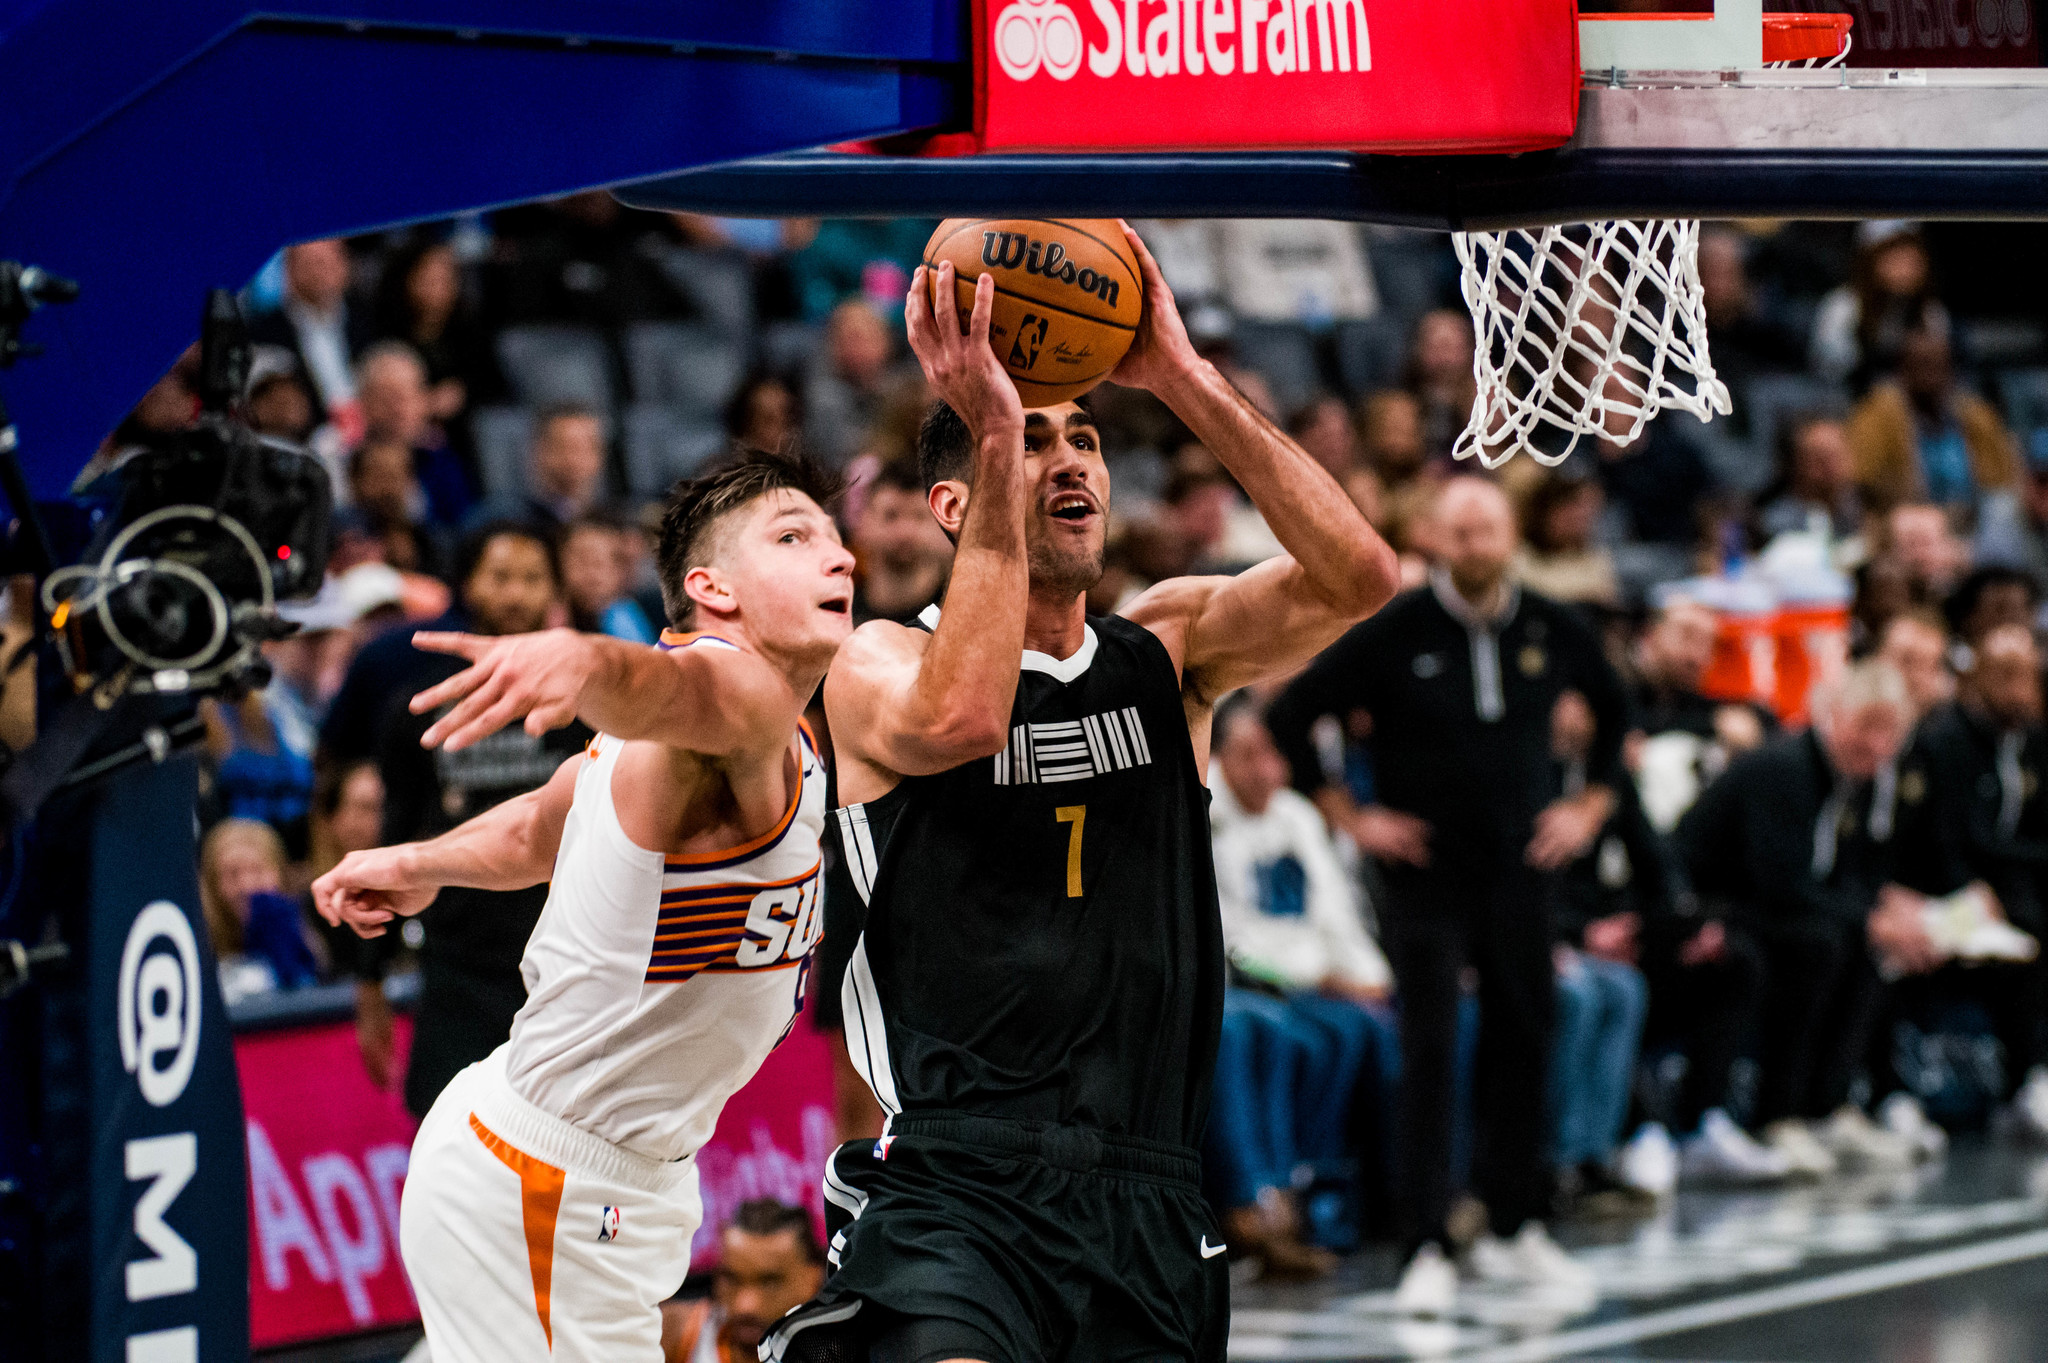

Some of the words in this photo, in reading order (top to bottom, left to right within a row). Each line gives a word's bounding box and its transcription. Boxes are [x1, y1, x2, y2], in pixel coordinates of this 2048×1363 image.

[981, 230, 1120, 309] Wilson
[1055, 804, 1086, 898] 7
[735, 876, 823, 967] SU
